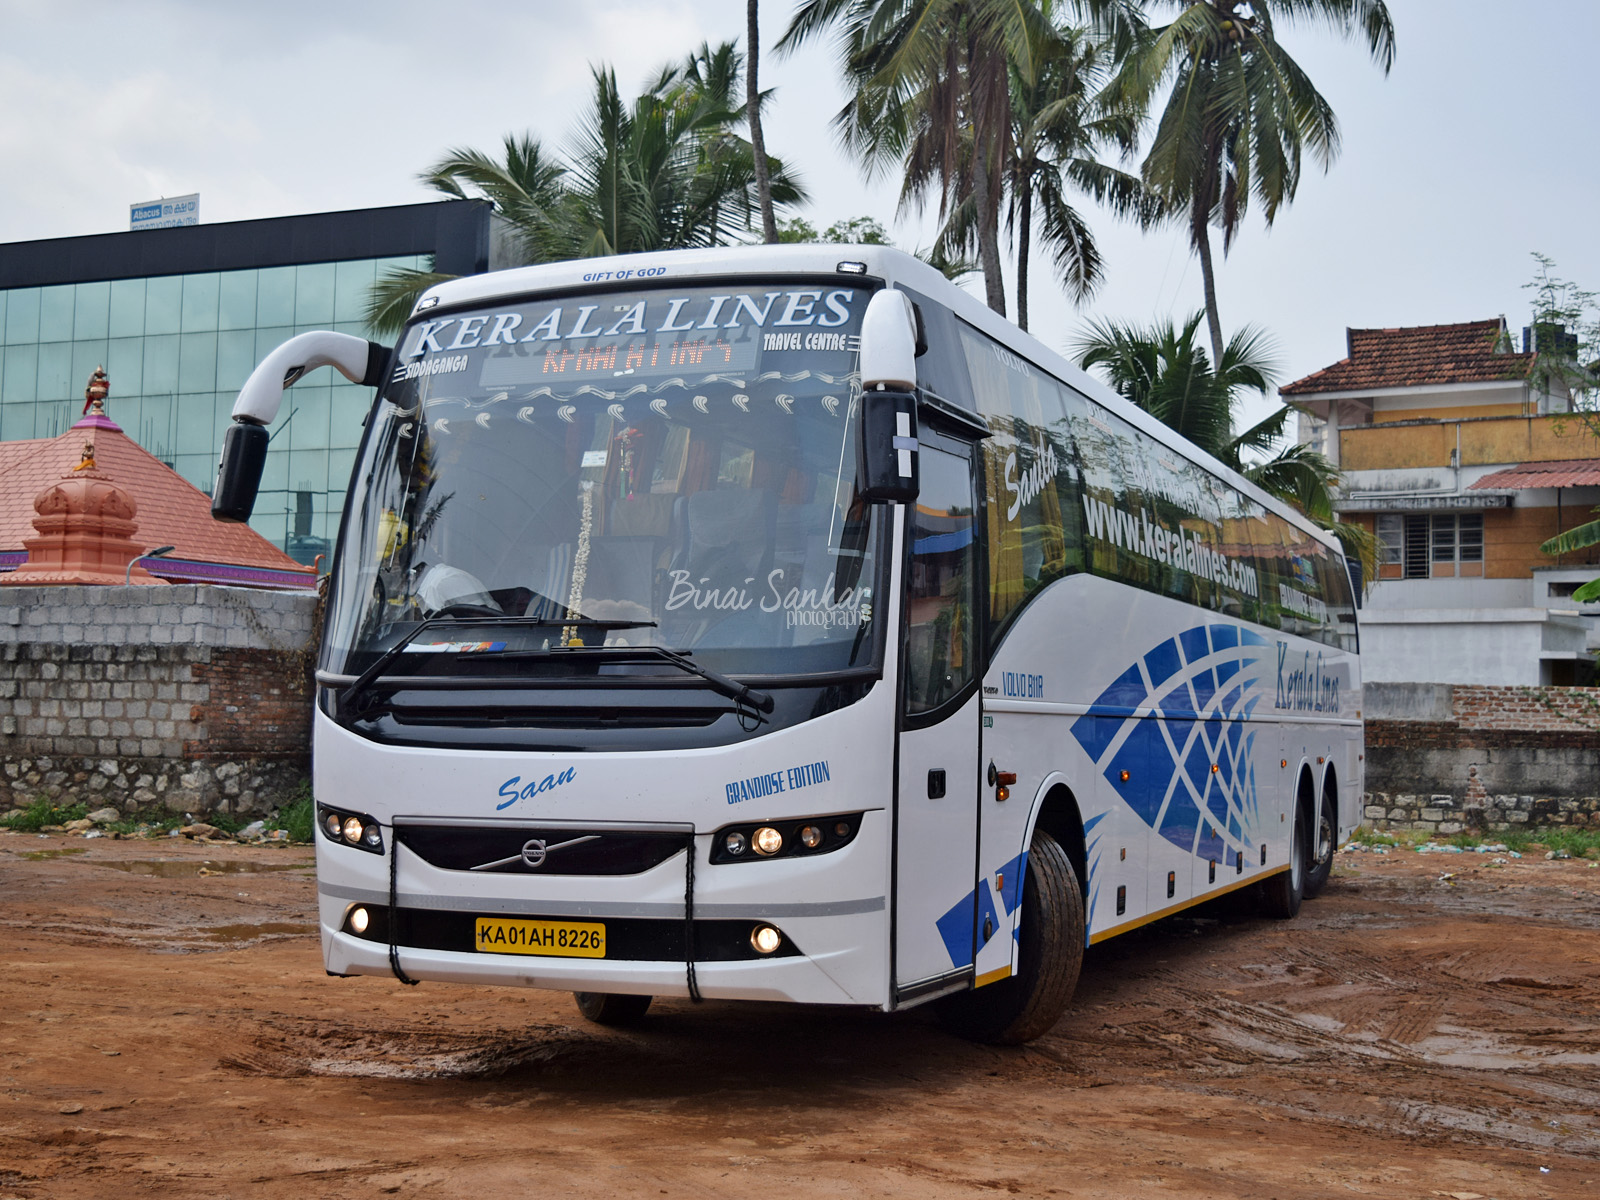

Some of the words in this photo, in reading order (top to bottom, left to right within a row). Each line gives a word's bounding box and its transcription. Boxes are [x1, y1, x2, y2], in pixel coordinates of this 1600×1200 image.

[133, 208, 160, 220] Abacus
[583, 272, 613, 282] GIFT
[616, 270, 634, 280] OF
[637, 267, 667, 277] GOD
[763, 333, 802, 351] TRAVEL
[805, 332, 847, 351] CENTRE
[405, 354, 469, 380] SIDDAGANGA
[991, 343, 1030, 378] VOLVO
[1082, 494, 1258, 598] www.keralalines.com
[1002, 671, 1026, 697] VOLVO
[1275, 640, 1313, 712] Kerala
[1315, 650, 1339, 713] Lines
[496, 766, 577, 811] Saan
[725, 771, 786, 805] GRANDIOSE
[787, 760, 831, 790] EDITION
